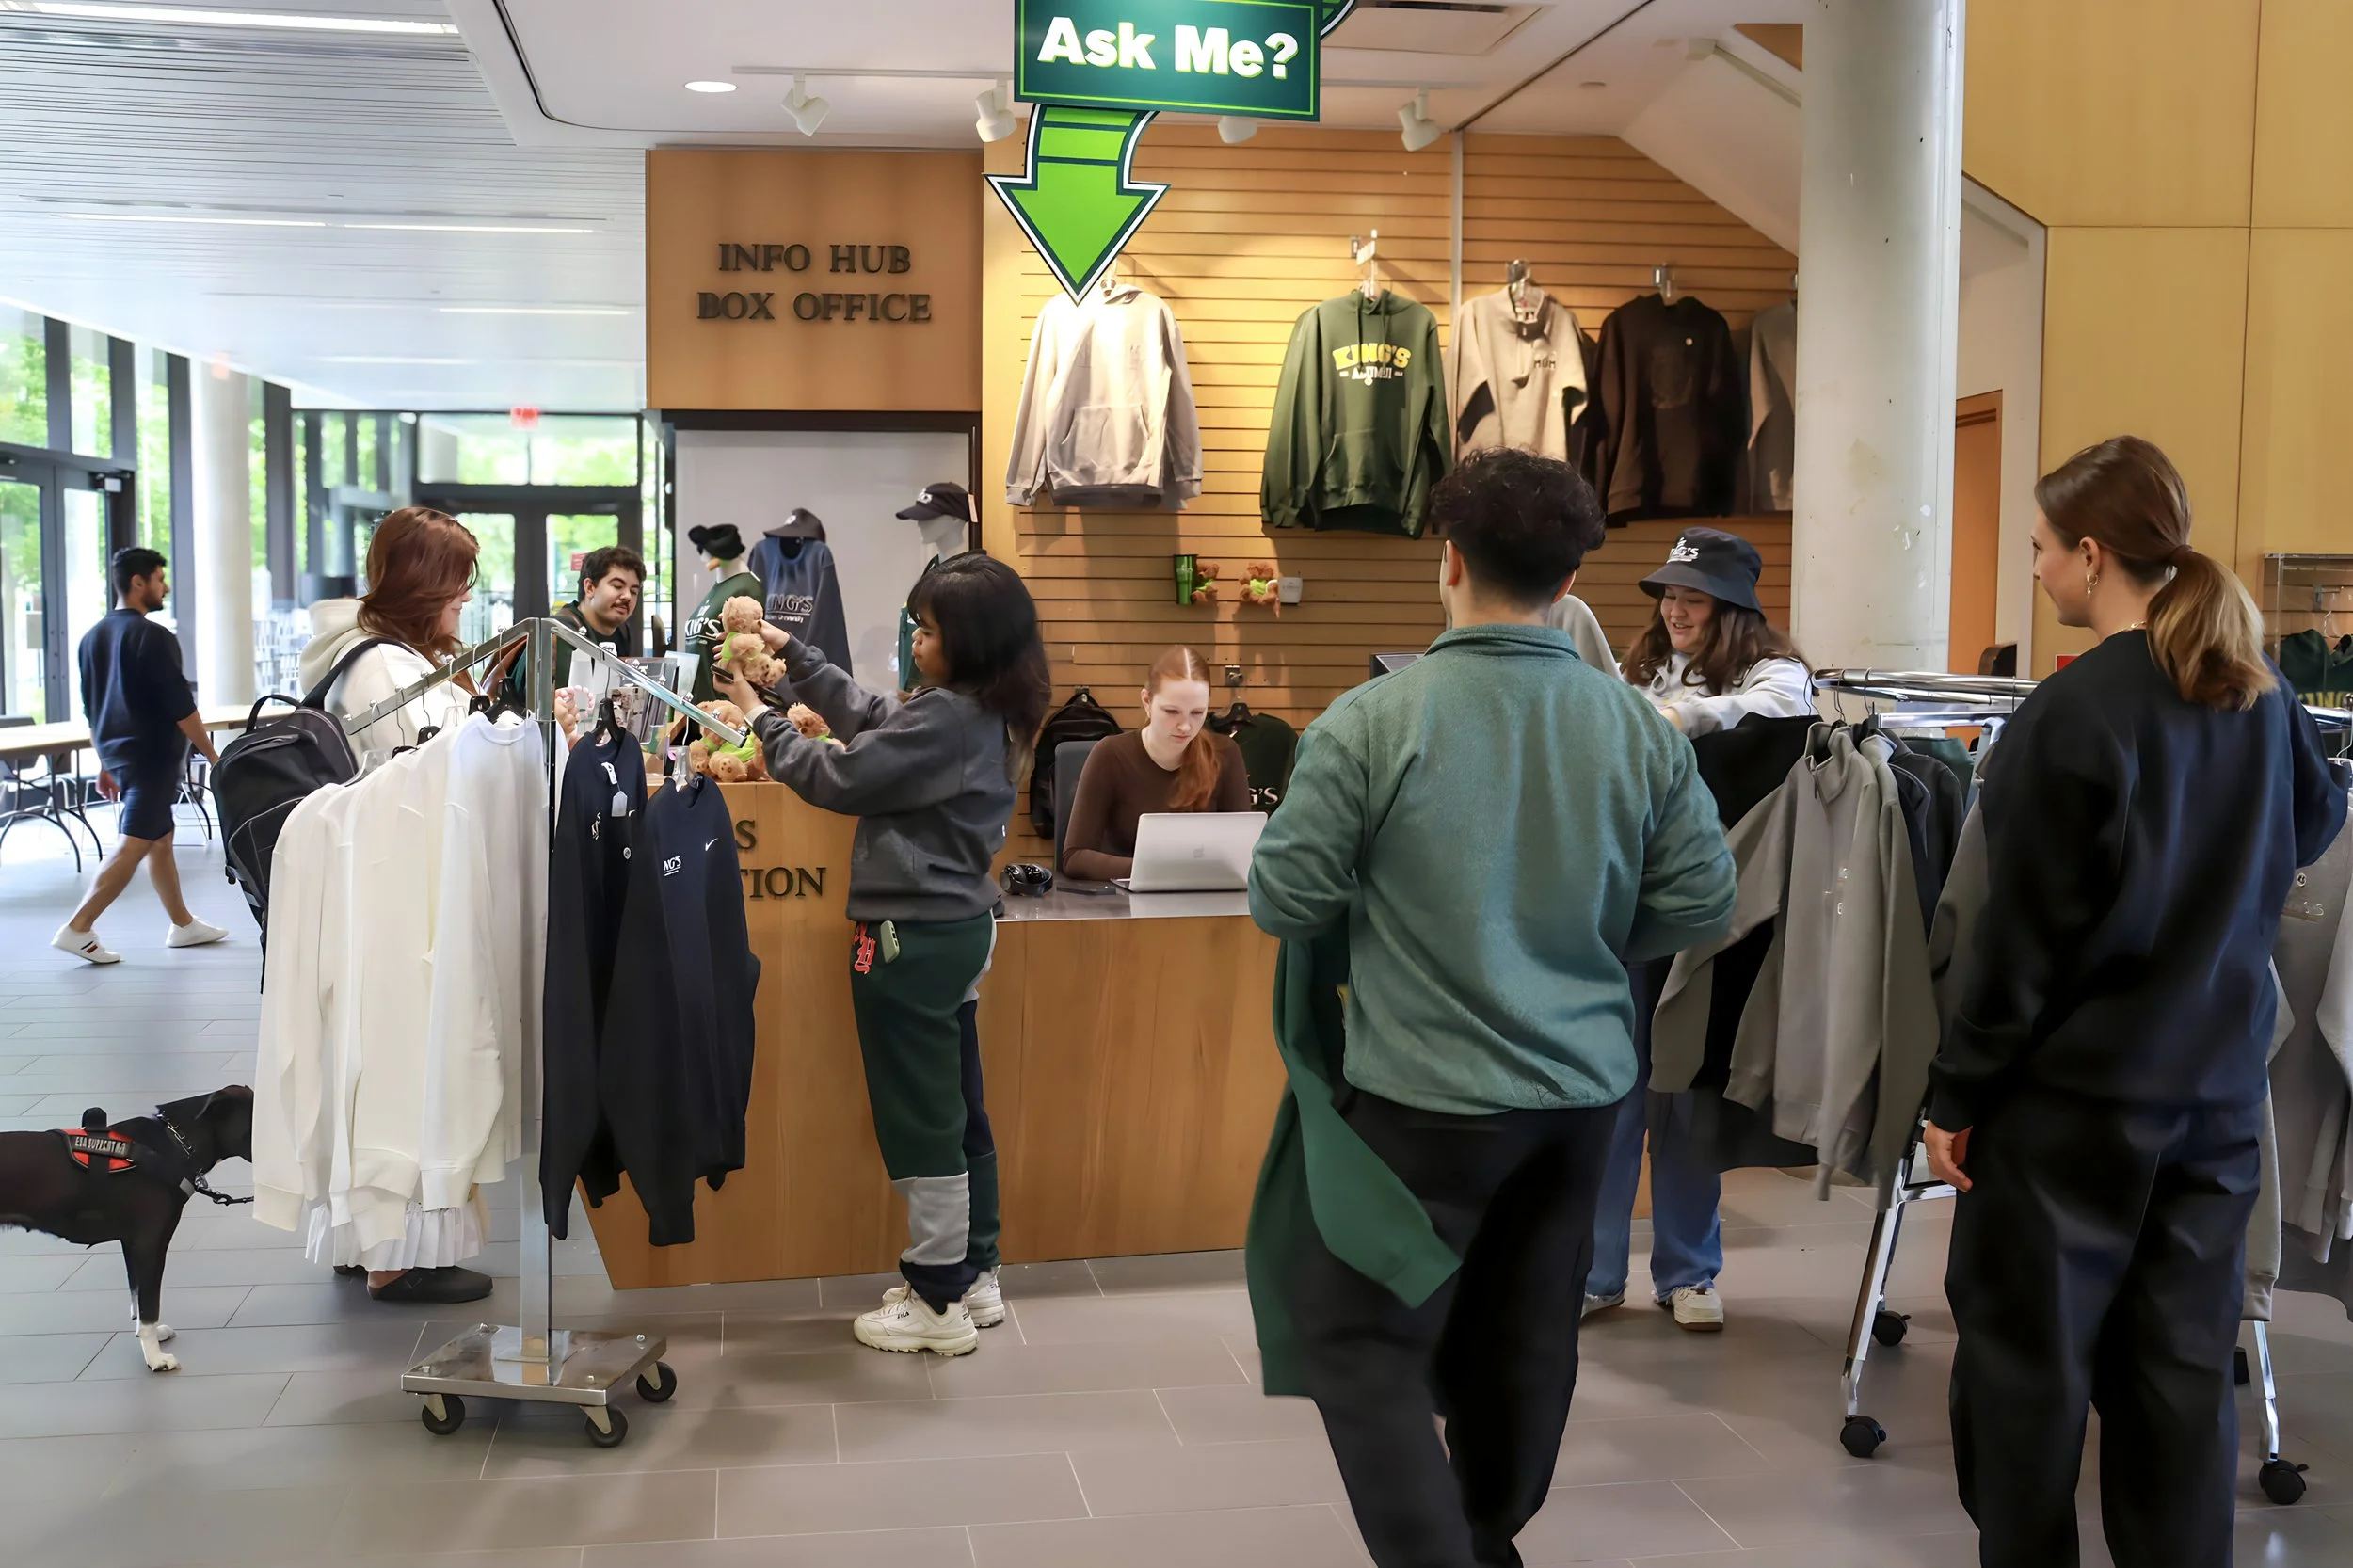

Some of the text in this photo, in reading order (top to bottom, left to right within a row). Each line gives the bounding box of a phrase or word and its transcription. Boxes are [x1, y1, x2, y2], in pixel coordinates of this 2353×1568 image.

[1037, 16, 1299, 80] Ask Me?
[718, 243, 911, 274] INFO HUB
[696, 292, 932, 321] BOX OFFICE
[1332, 343, 1412, 370] KING'S
[740, 867, 826, 898] ION
